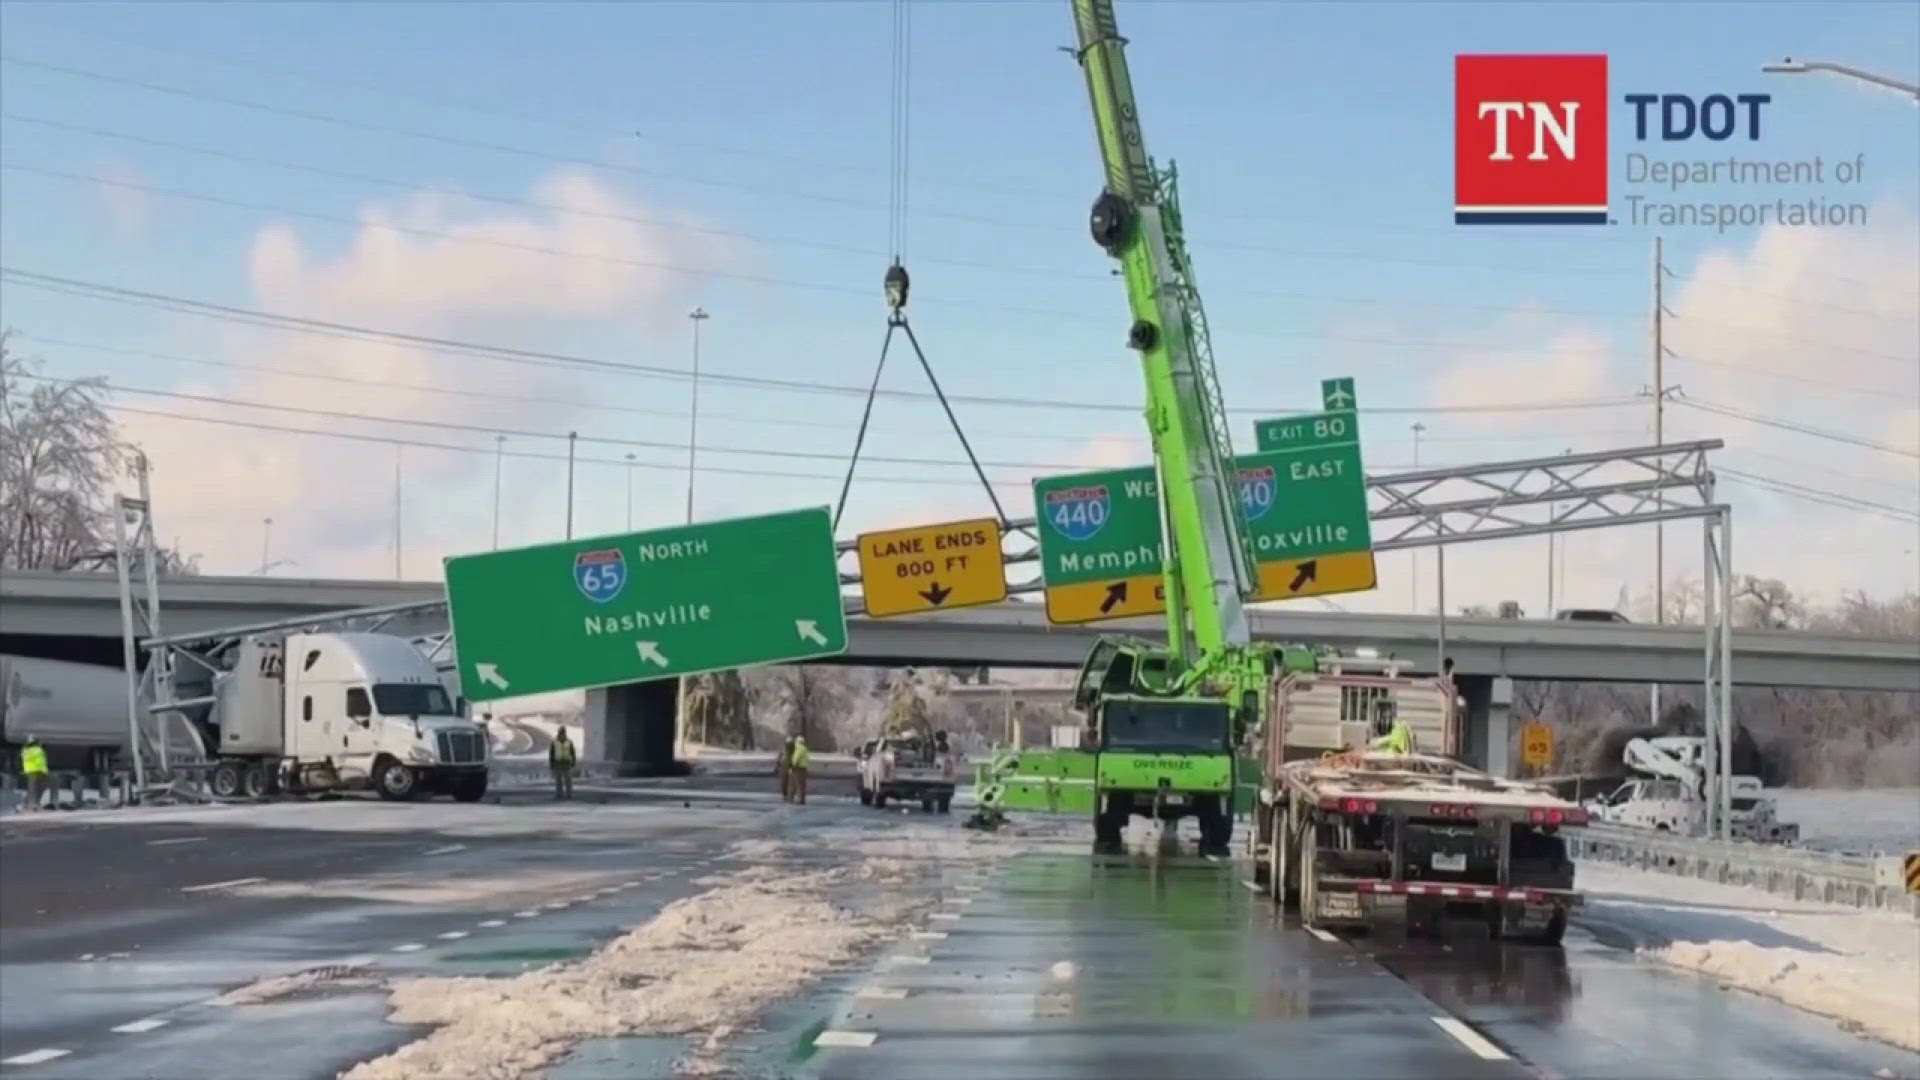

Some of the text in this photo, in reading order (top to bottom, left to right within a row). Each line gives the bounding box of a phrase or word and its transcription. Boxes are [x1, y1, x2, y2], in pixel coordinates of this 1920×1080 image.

[1268, 417, 1345, 440] EXIT 80
[1290, 459, 1344, 480] EAST
[1124, 480, 1157, 499] WE
[1240, 480, 1270, 508] 40
[1055, 500, 1104, 528] 440
[872, 530, 986, 558] LANE ENDS
[1257, 524, 1348, 550] oxville
[639, 539, 709, 563] NORTH
[1060, 542, 1164, 573] Memphi
[583, 563, 620, 592] 65
[896, 555, 967, 578] 800 FT
[584, 603, 711, 636] Nashville
[1133, 759, 1193, 769] OVERSIZE
